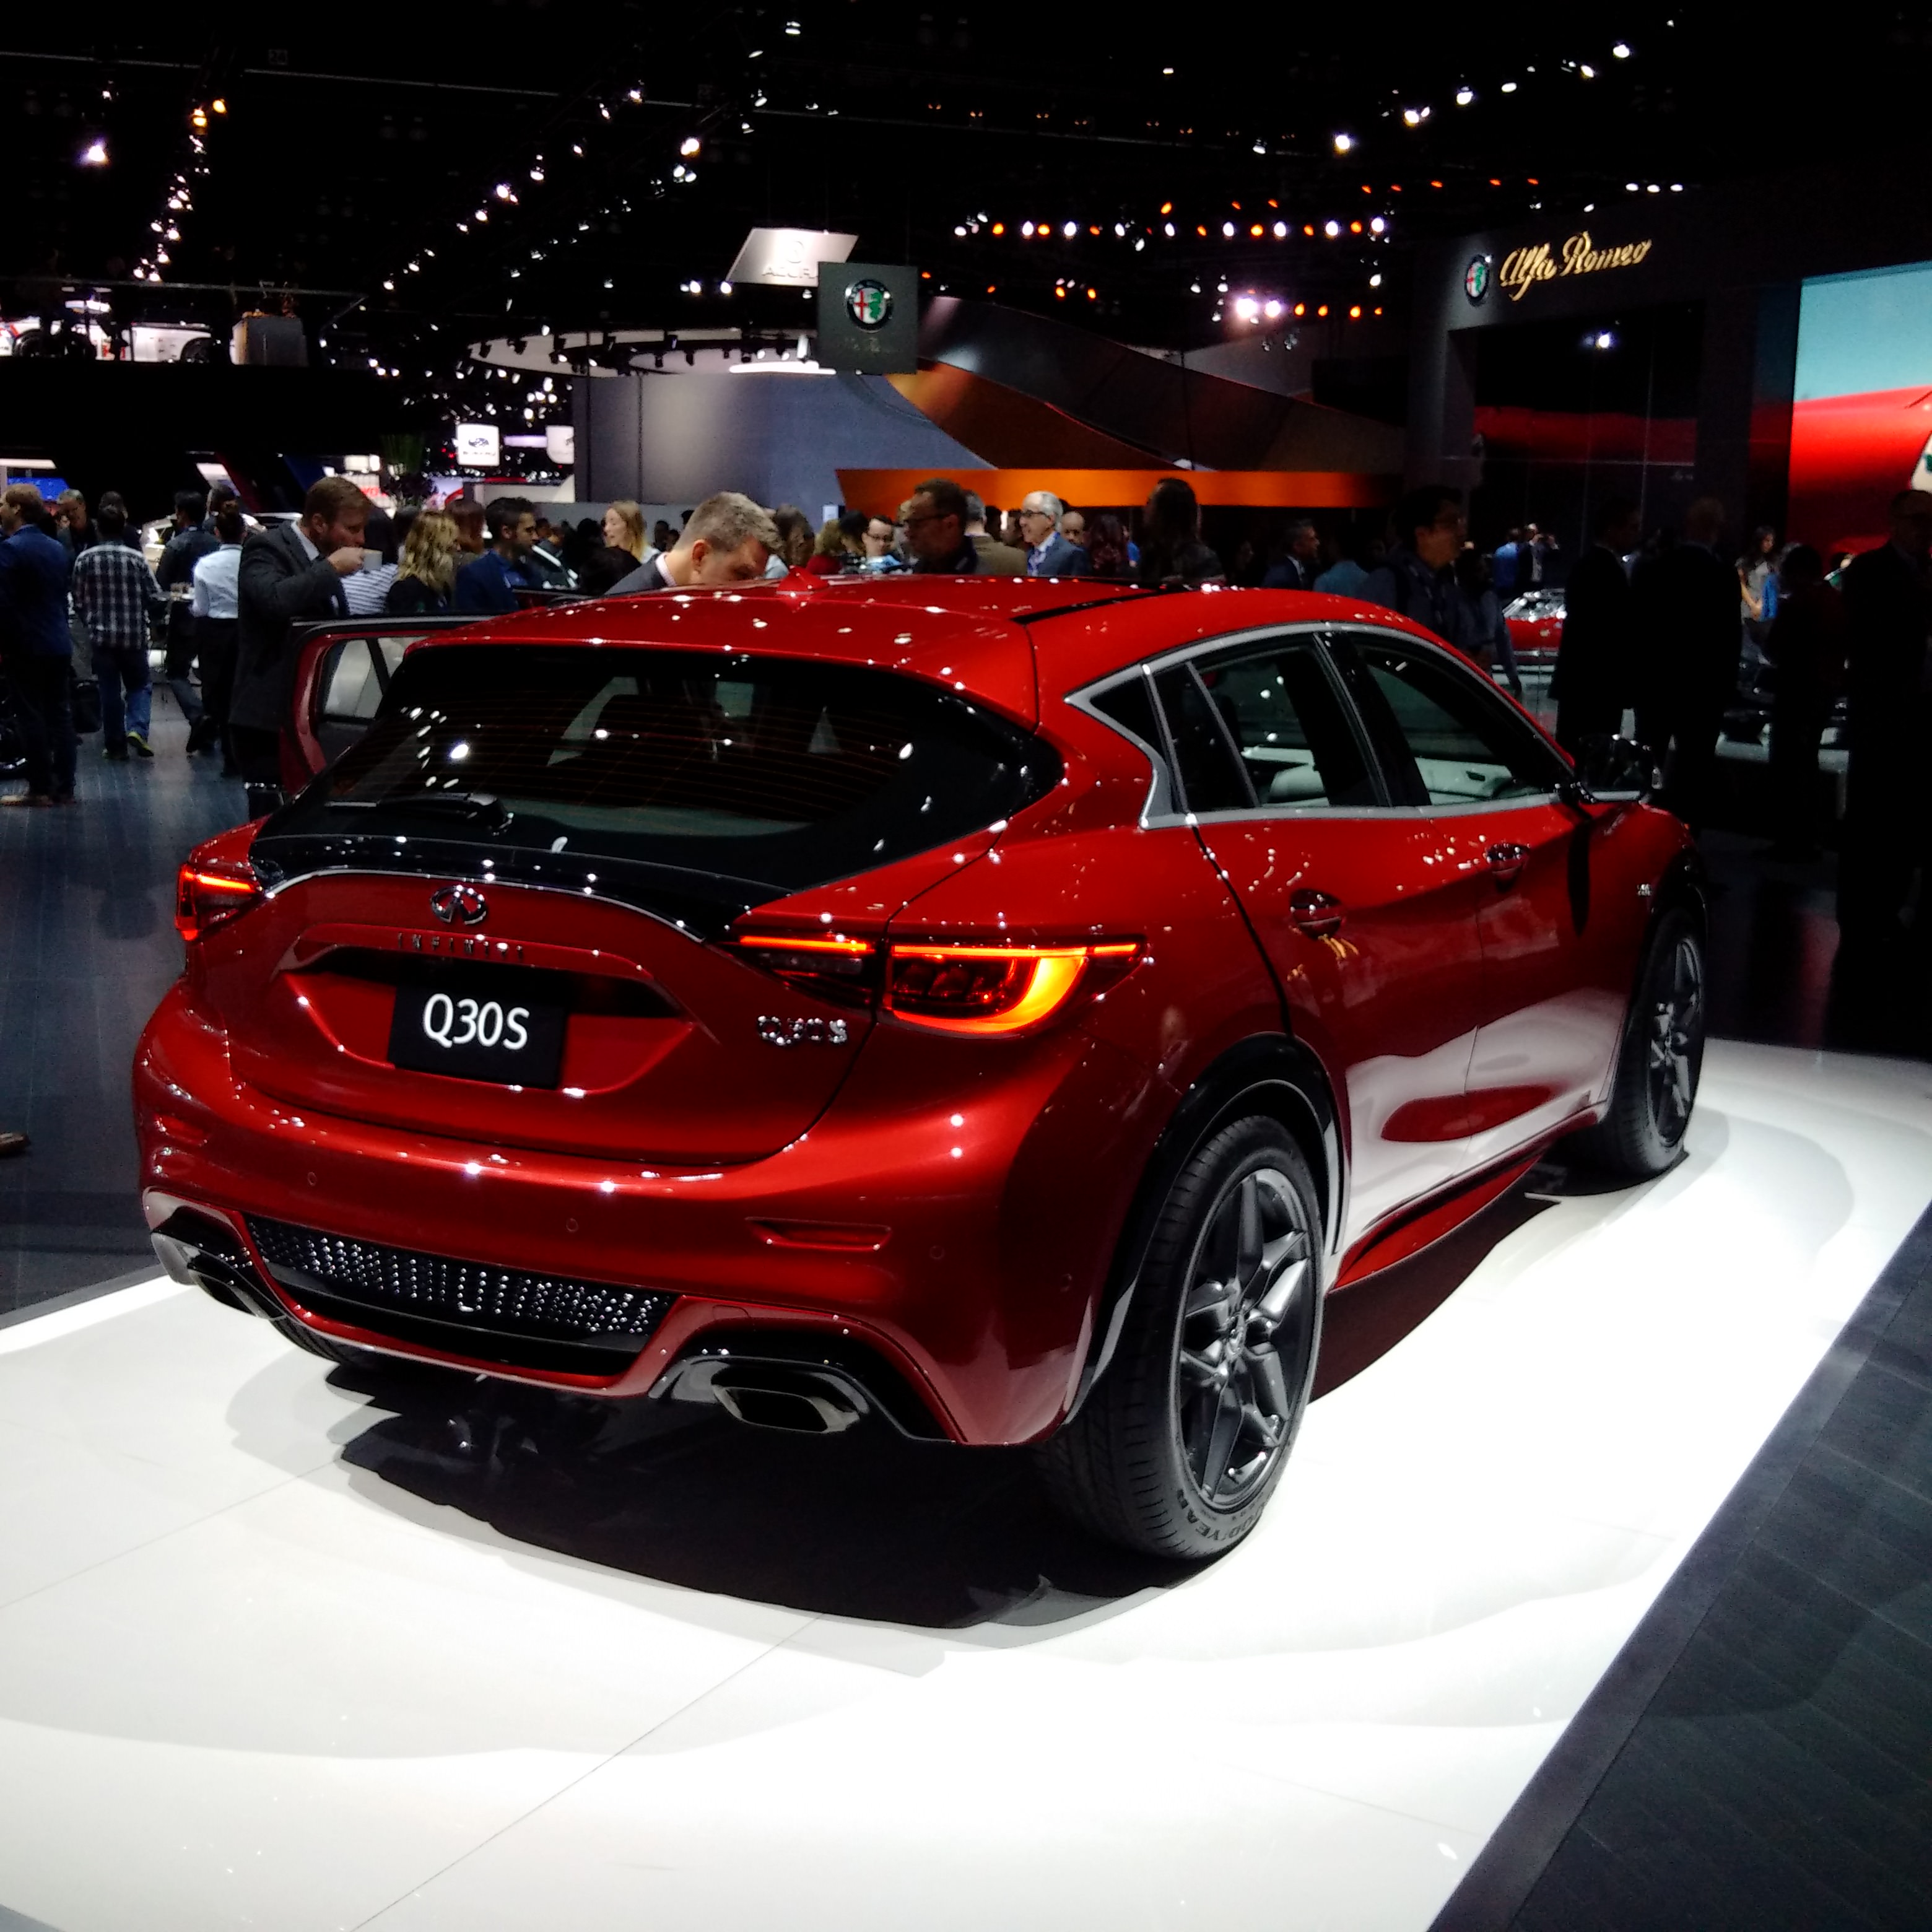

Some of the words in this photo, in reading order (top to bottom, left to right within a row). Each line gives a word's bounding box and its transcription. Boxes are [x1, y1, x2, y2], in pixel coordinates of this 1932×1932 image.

[1499, 242, 1558, 302] Alfa
[1559, 230, 1653, 277] Romeo
[422, 993, 530, 1049] Q30S
